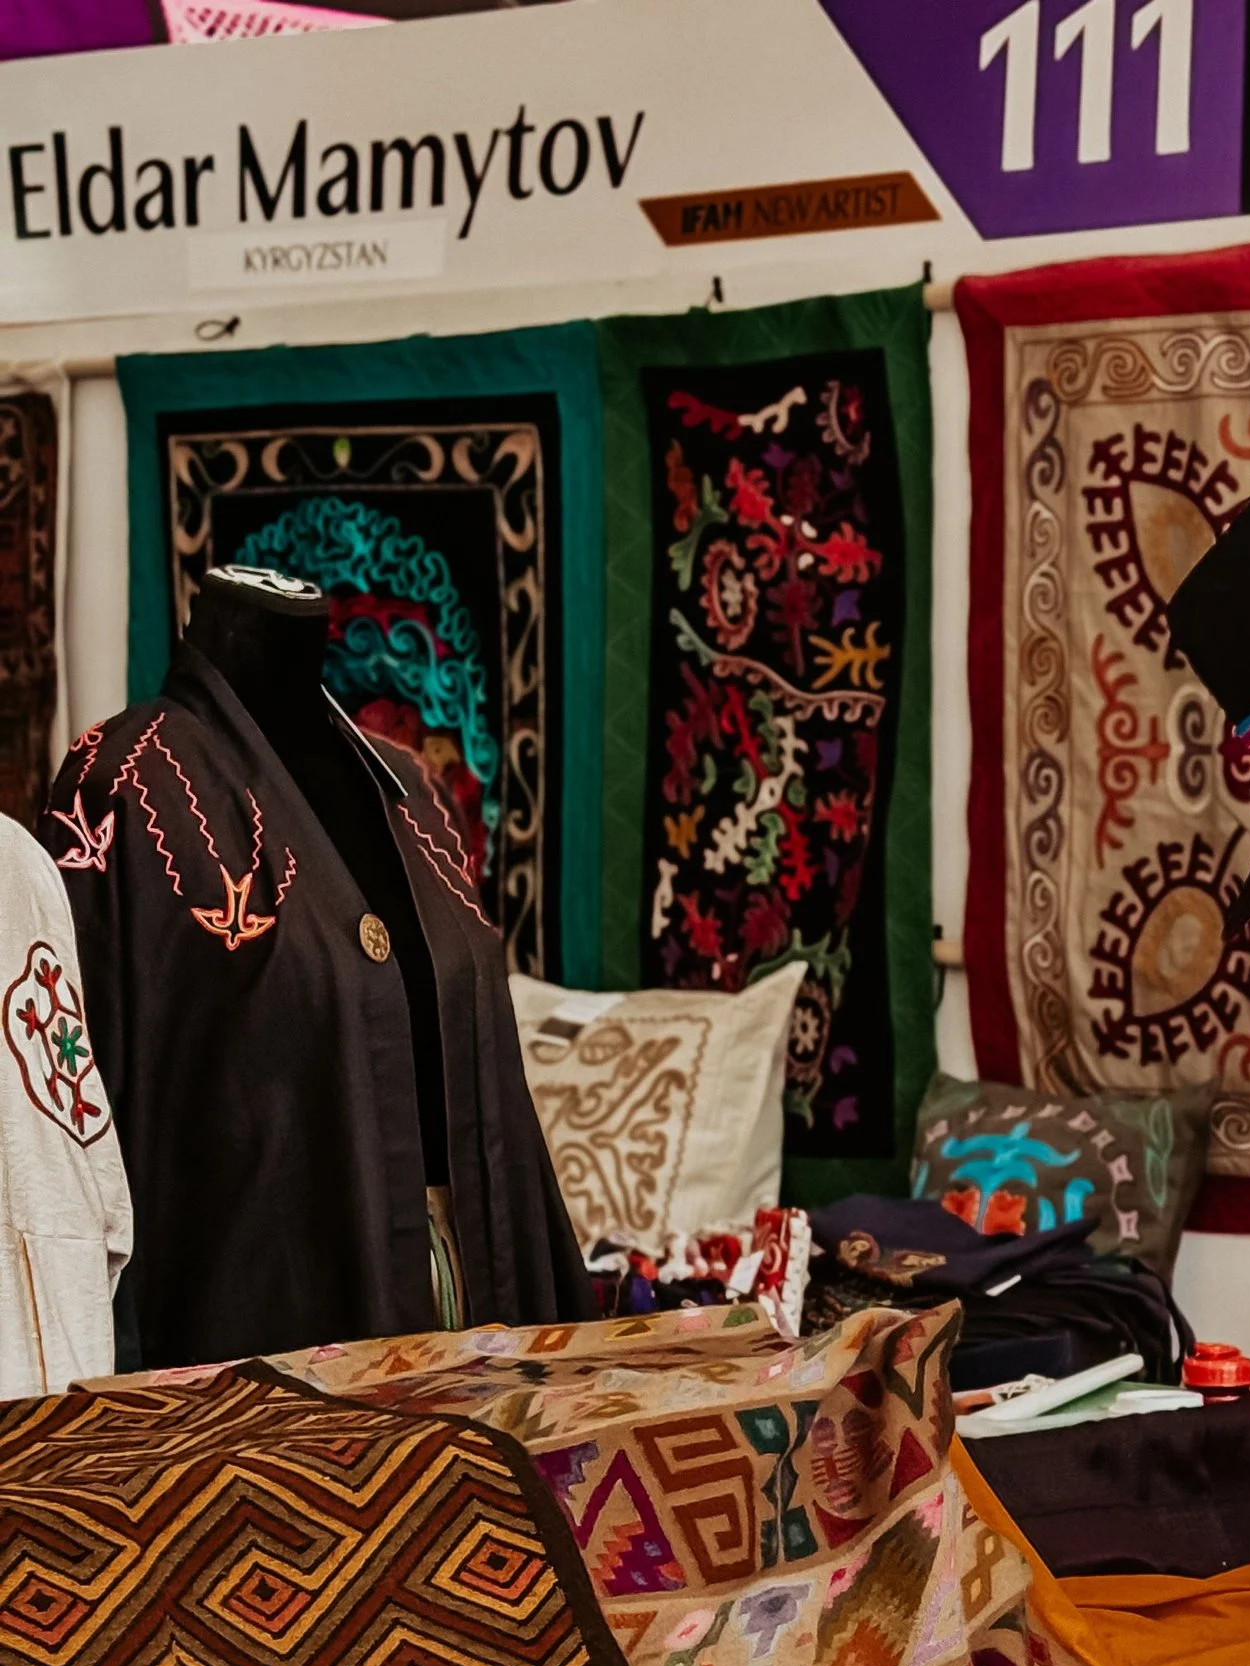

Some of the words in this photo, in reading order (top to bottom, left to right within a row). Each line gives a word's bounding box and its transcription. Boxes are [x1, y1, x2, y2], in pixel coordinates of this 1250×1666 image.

[979, 0, 1193, 172] 111
[8, 126, 214, 241] Eldar
[238, 104, 645, 240] Mamytov
[680, 200, 743, 235] IFAM
[752, 194, 810, 227] NEW
[815, 183, 901, 220] ARTIST
[243, 239, 388, 274] KYRGYZSTAN
